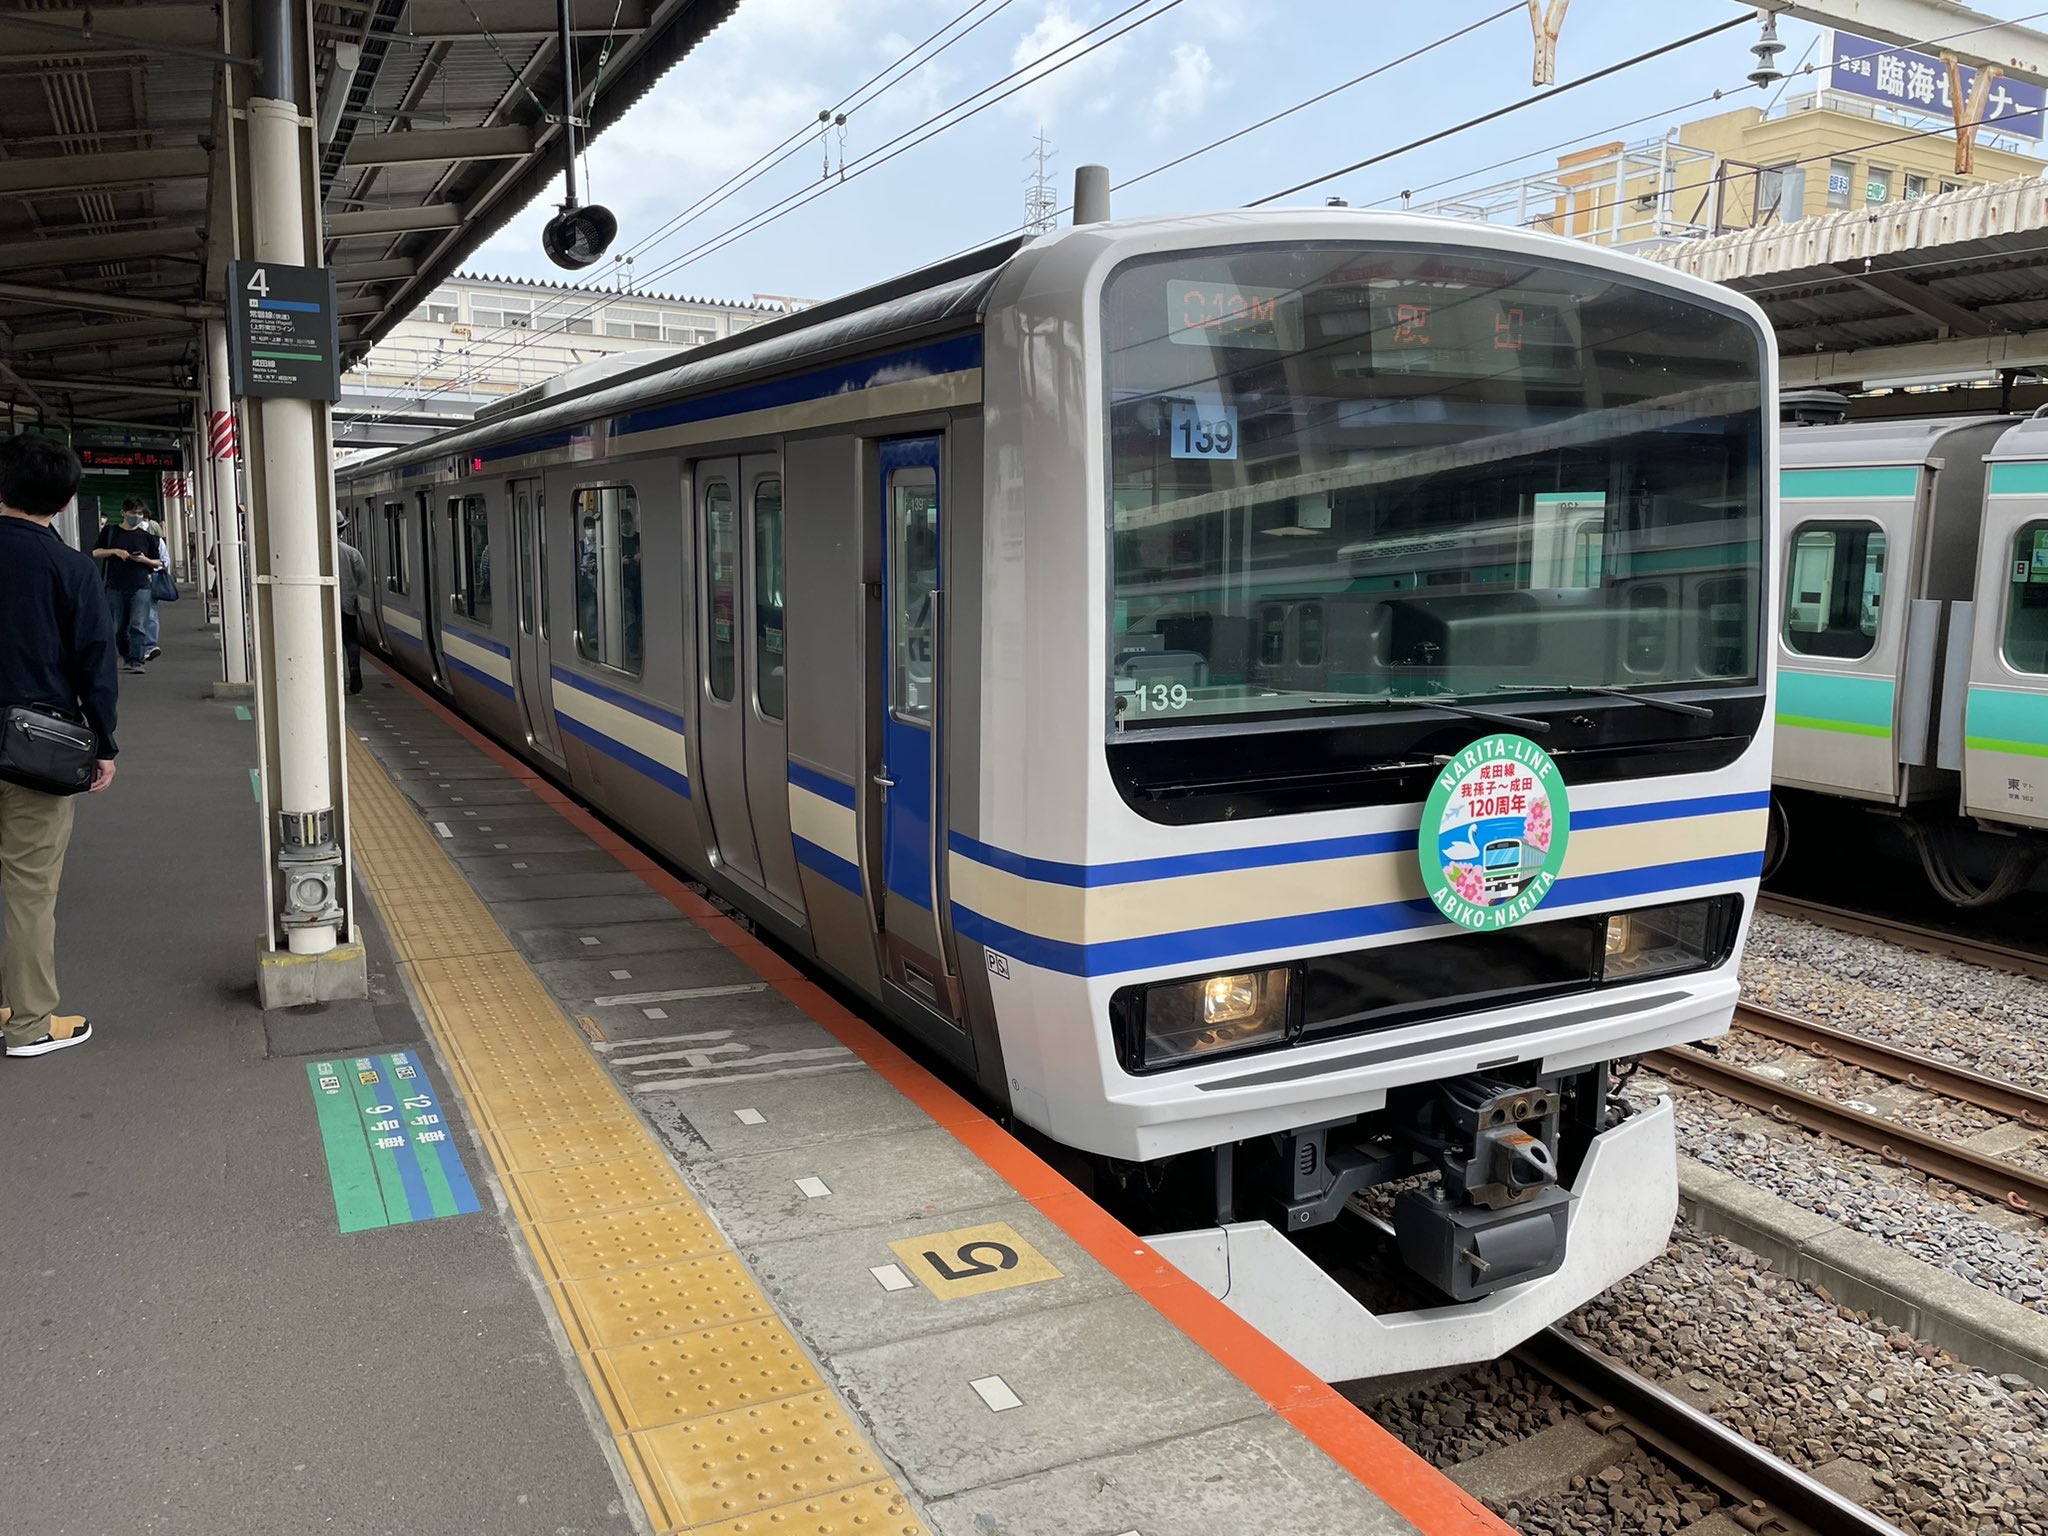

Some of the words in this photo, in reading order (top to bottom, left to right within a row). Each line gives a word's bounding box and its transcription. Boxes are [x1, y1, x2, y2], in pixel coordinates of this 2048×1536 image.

[247, 268, 270, 297] 4
[172, 439, 181, 448] 4
[1180, 419, 1232, 454] 139
[1136, 684, 1188, 712] 139
[1441, 739, 1553, 792] NARITA-LINE
[1480, 763, 1515, 780] 成田線
[2008, 778, 2020, 791] 東
[1468, 794, 1526, 818] 120周年
[1433, 870, 1555, 928] ABIKO-NARITA
[365, 1104, 405, 1149] 9号車
[403, 1094, 446, 1143] 12号車
[922, 1241, 1019, 1281] 5
